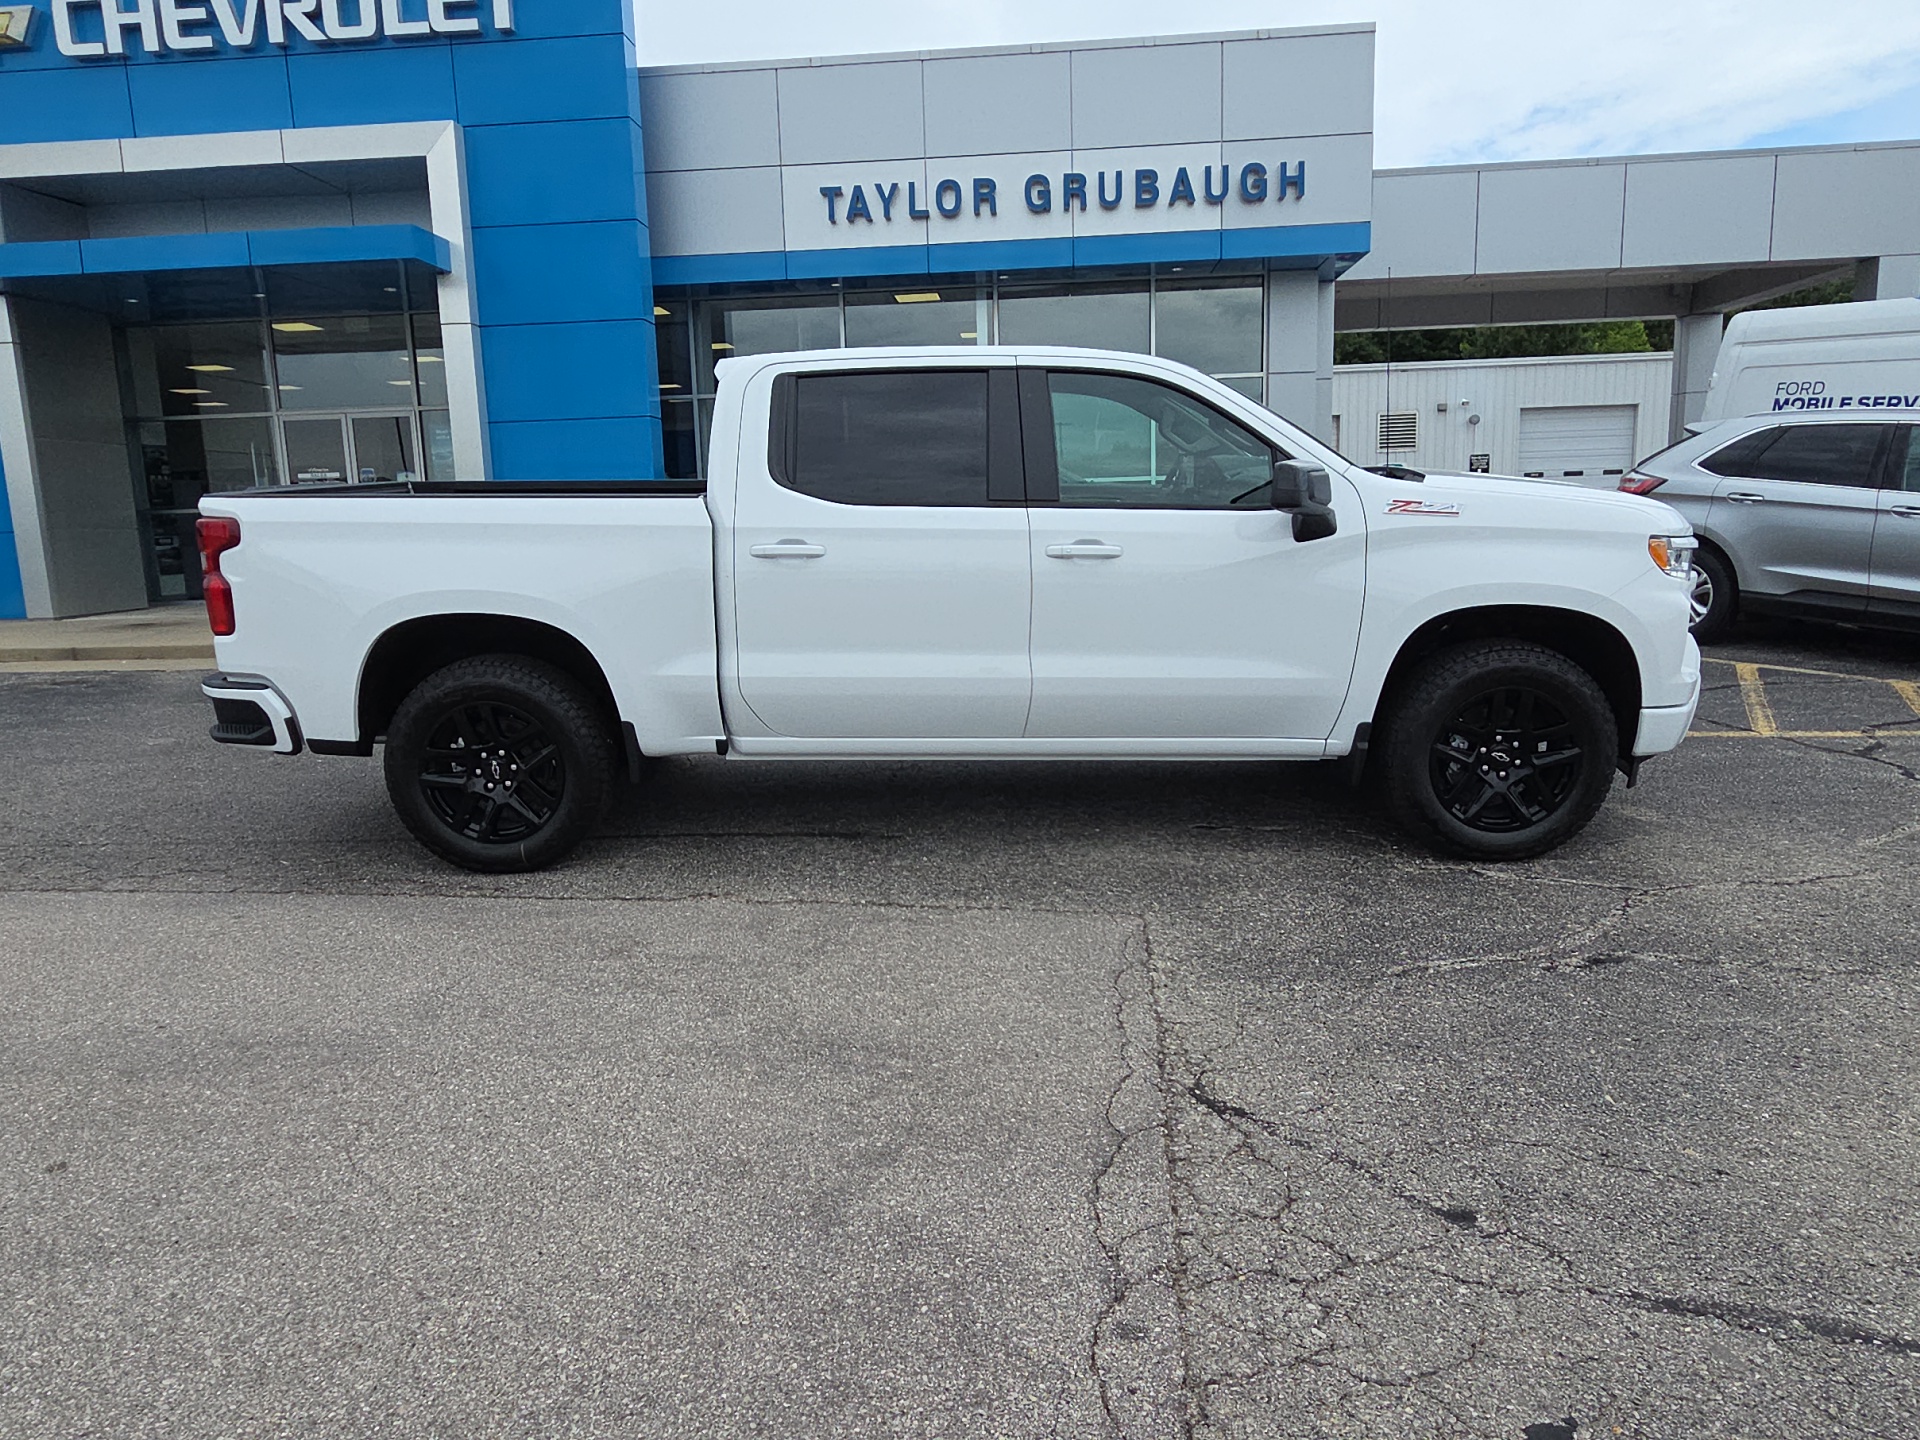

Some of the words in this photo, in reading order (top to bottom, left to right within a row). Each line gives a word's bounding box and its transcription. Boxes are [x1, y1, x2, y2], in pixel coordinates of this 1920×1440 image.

[820, 177, 998, 224] TAYLOR
[1023, 160, 1306, 214] GRUBAUGH
[1775, 381, 1826, 396] FORD
[1772, 396, 1853, 412] MOBILE
